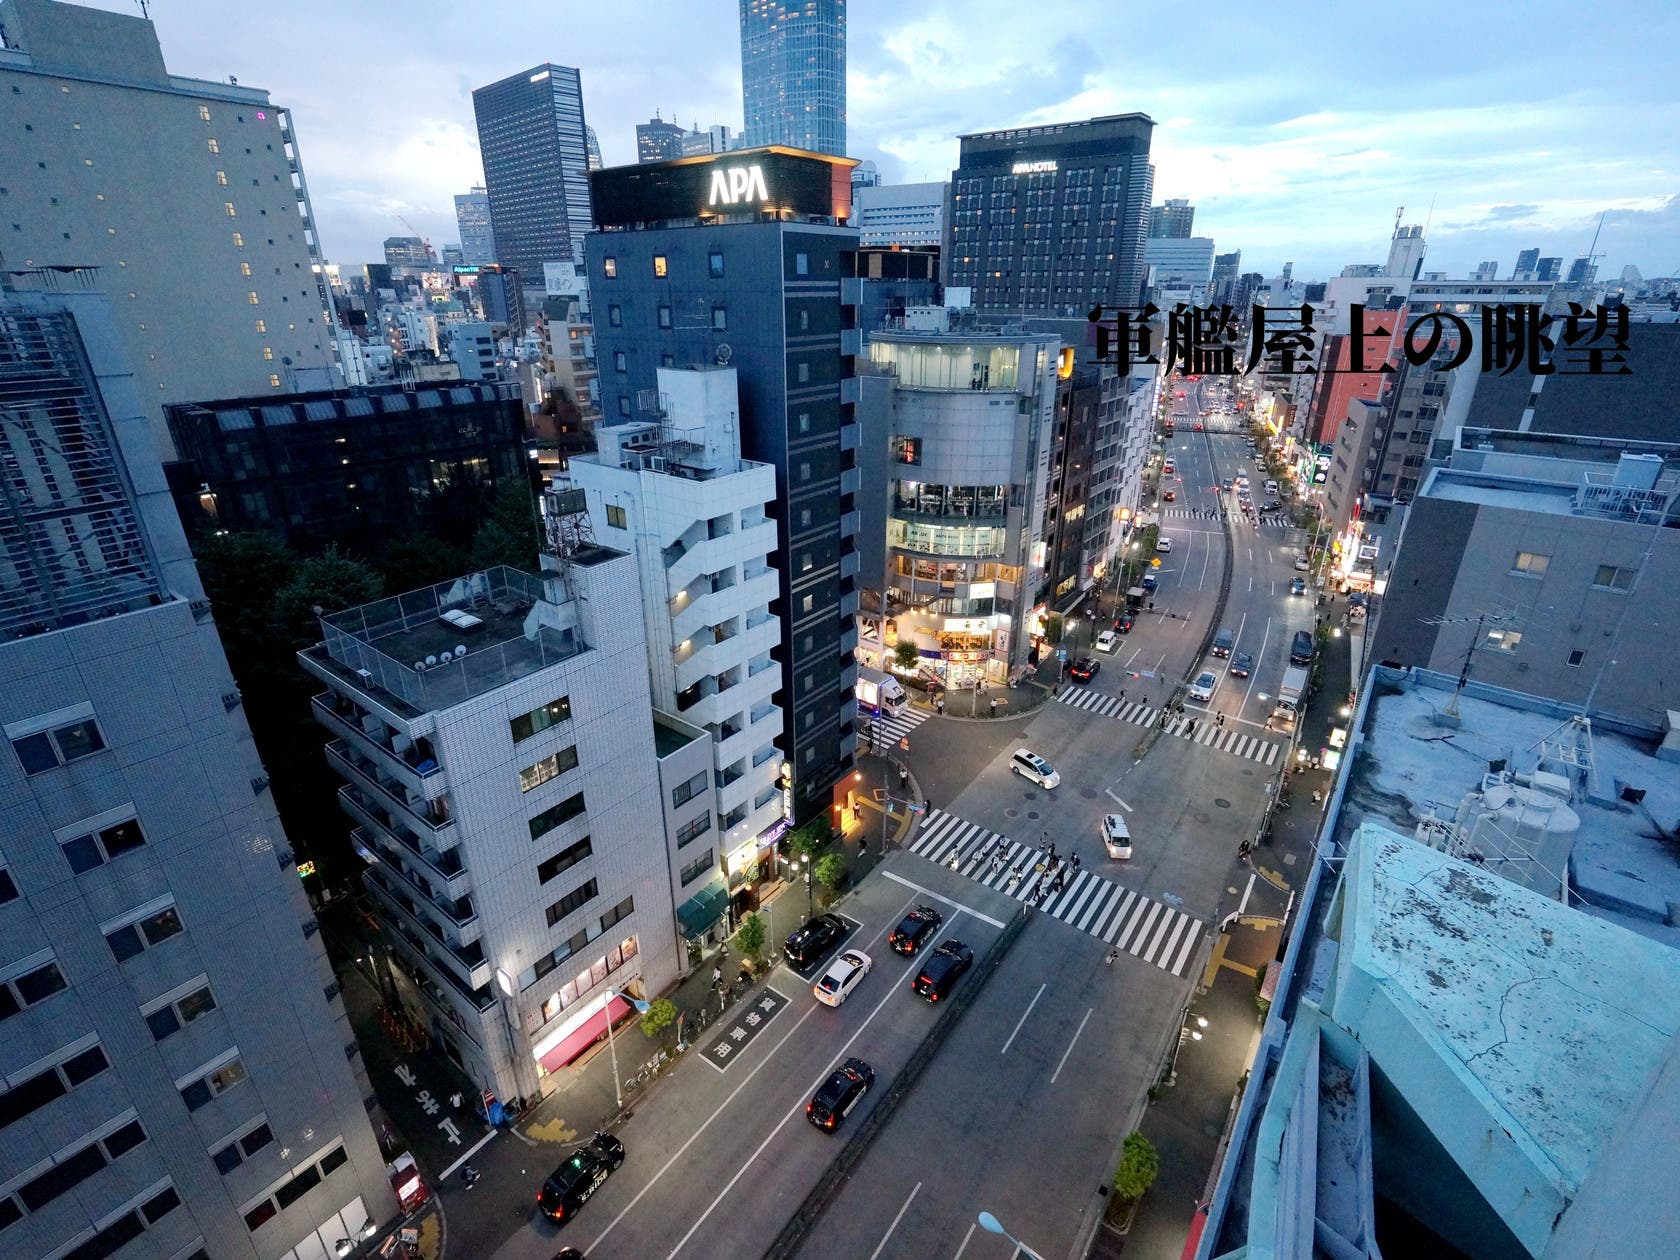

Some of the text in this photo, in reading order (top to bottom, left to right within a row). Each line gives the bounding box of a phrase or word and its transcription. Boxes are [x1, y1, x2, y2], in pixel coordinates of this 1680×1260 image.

[709, 165, 769, 206] APA
[1029, 160, 1058, 173] HOTEL
[393, 1063, 462, 1145] 止まれ
